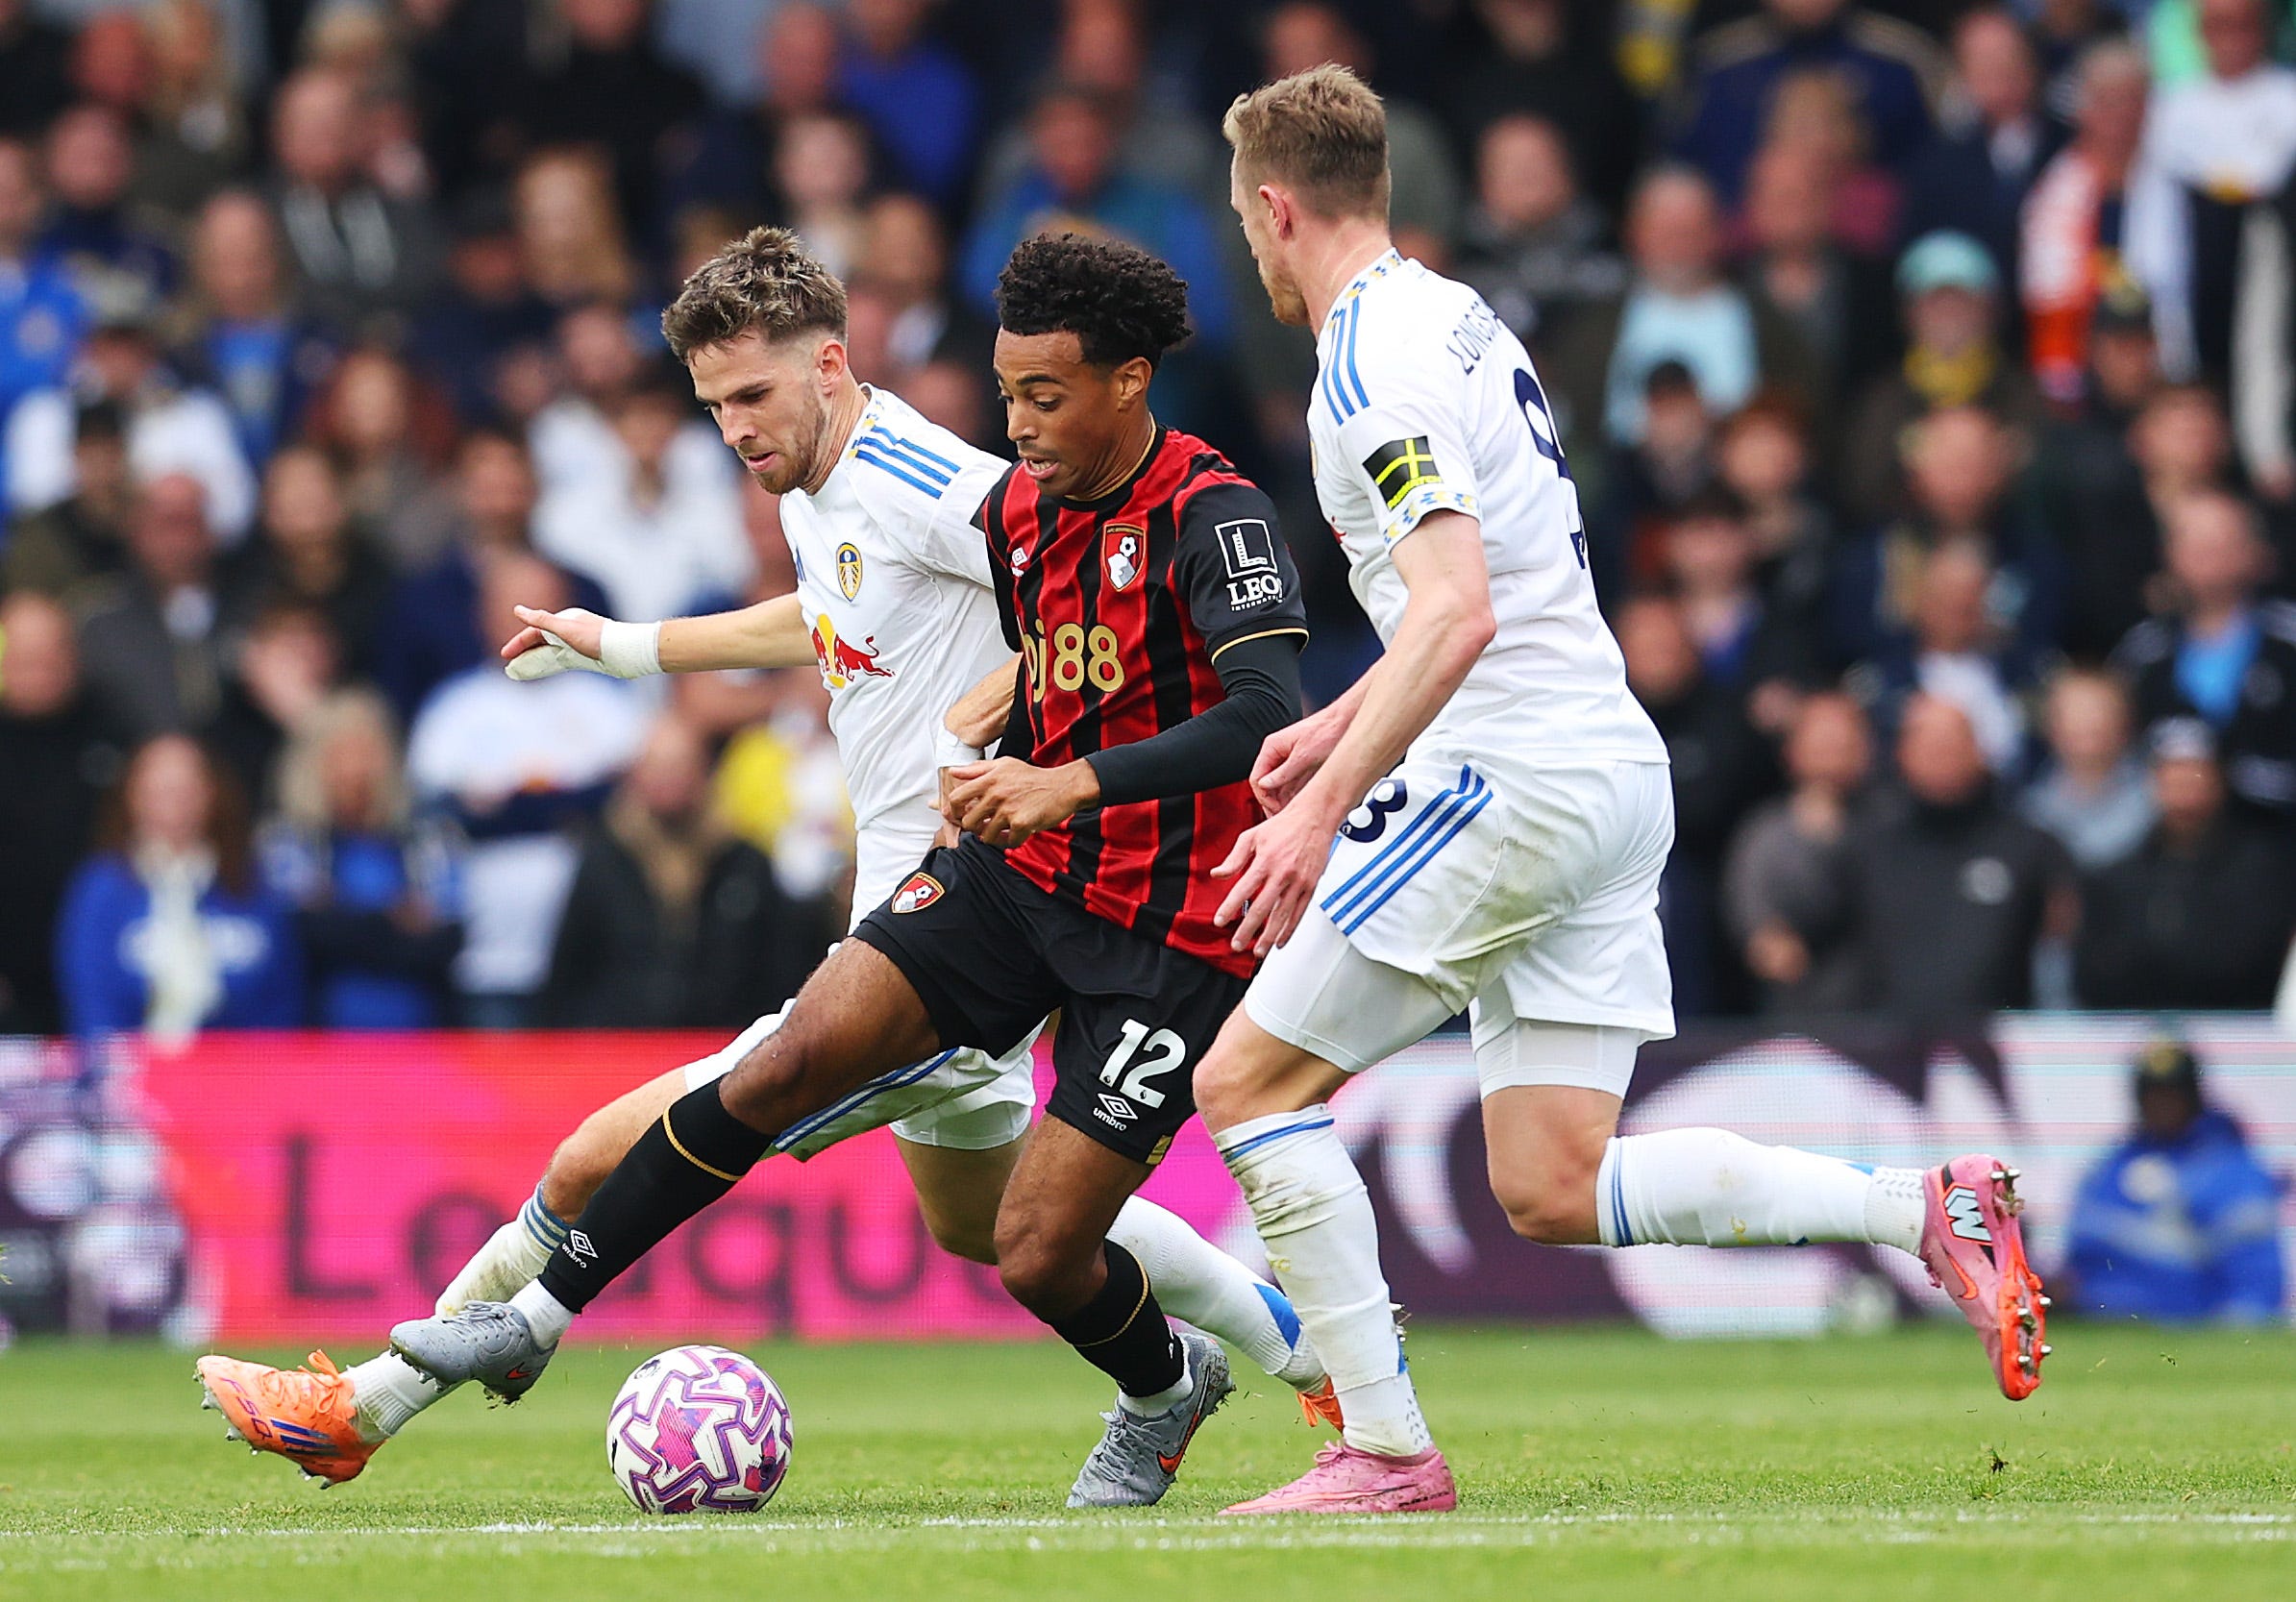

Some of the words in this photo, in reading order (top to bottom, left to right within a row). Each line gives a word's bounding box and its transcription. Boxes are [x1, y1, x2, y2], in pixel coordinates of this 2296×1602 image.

[1446, 299, 1501, 376] LONGS
[1099, 1018, 1187, 1109] 12
[1093, 1106, 1127, 1132] umbro
[561, 1242, 587, 1269] umbro
